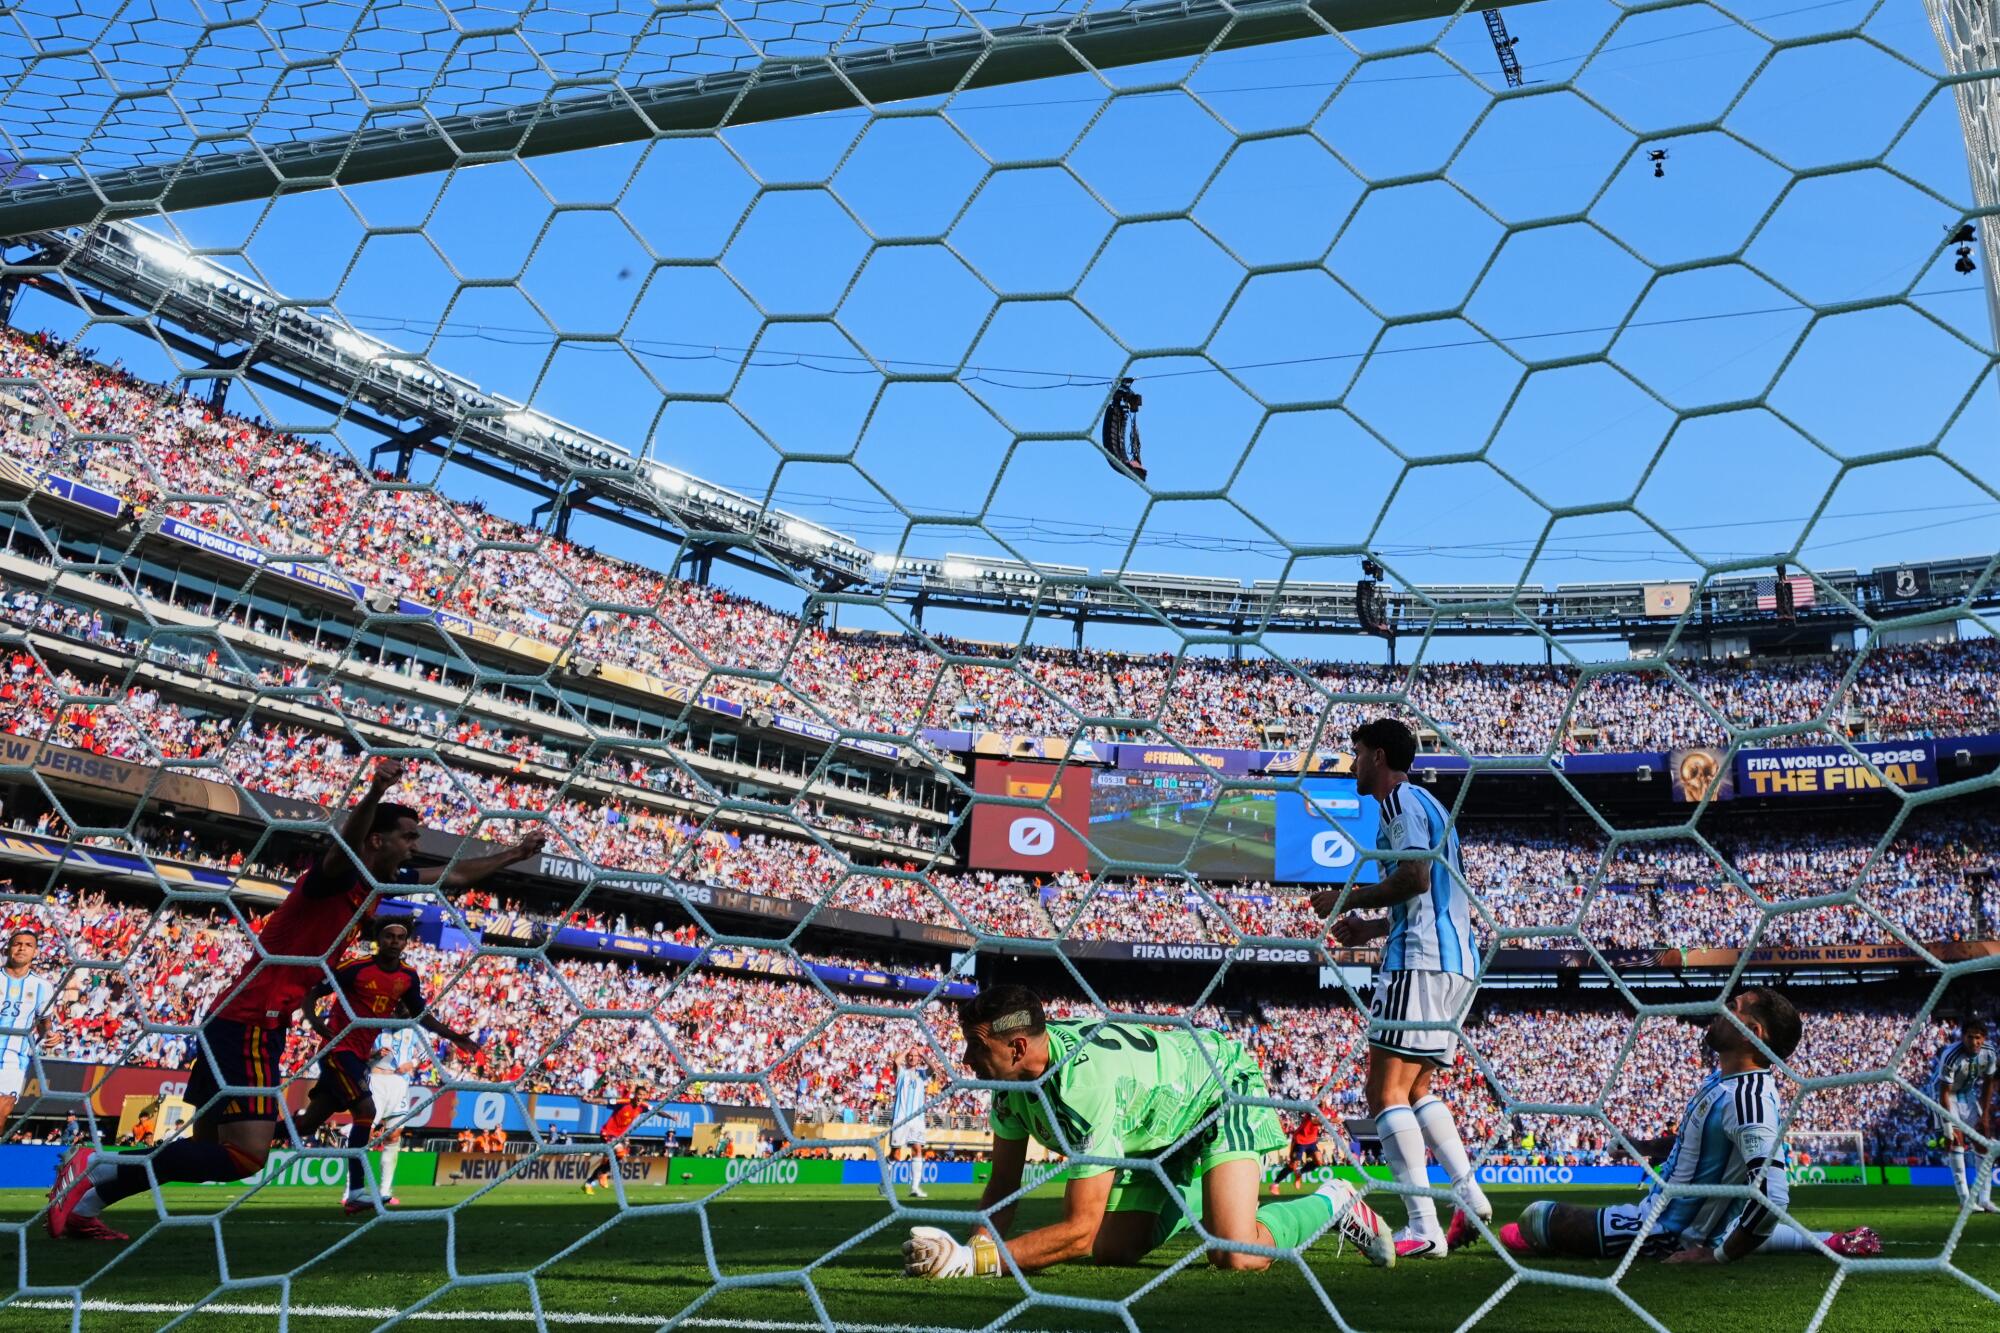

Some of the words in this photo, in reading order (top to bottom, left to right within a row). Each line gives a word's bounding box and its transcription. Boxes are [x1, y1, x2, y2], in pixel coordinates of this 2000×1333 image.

[174, 523, 197, 541] FIFA
[198, 532, 235, 554] WORLD
[296, 567, 319, 583] THE
[319, 575, 351, 594] FINA
[35, 750, 132, 784] JERSEY
[1747, 758, 1778, 770] FIFA
[1781, 754, 1837, 769] WORLD
[1871, 749, 1927, 764] 2026
[1749, 768, 1818, 793] THE
[1824, 763, 1928, 790] FINAL
[1008, 817, 1055, 856] 0
[1311, 830, 1356, 868] 0
[540, 857, 574, 879] FIFA
[715, 891, 748, 908] THE
[750, 895, 794, 917] FINAL
[1132, 945, 1166, 959] FIFA
[1167, 946, 1222, 960] WORLD
[1224, 948, 1255, 961] CUP
[1257, 948, 1310, 962] 2026
[1353, 951, 1381, 963] FIN
[1777, 949, 1821, 960] YORK
[1825, 948, 1862, 959] NEW
[0, 1001, 23, 1018] 25
[473, 1091, 506, 1129] 0
[460, 1159, 501, 1180] NEW
[554, 1160, 591, 1180] NEW
[1482, 1166, 1574, 1183] aramco
